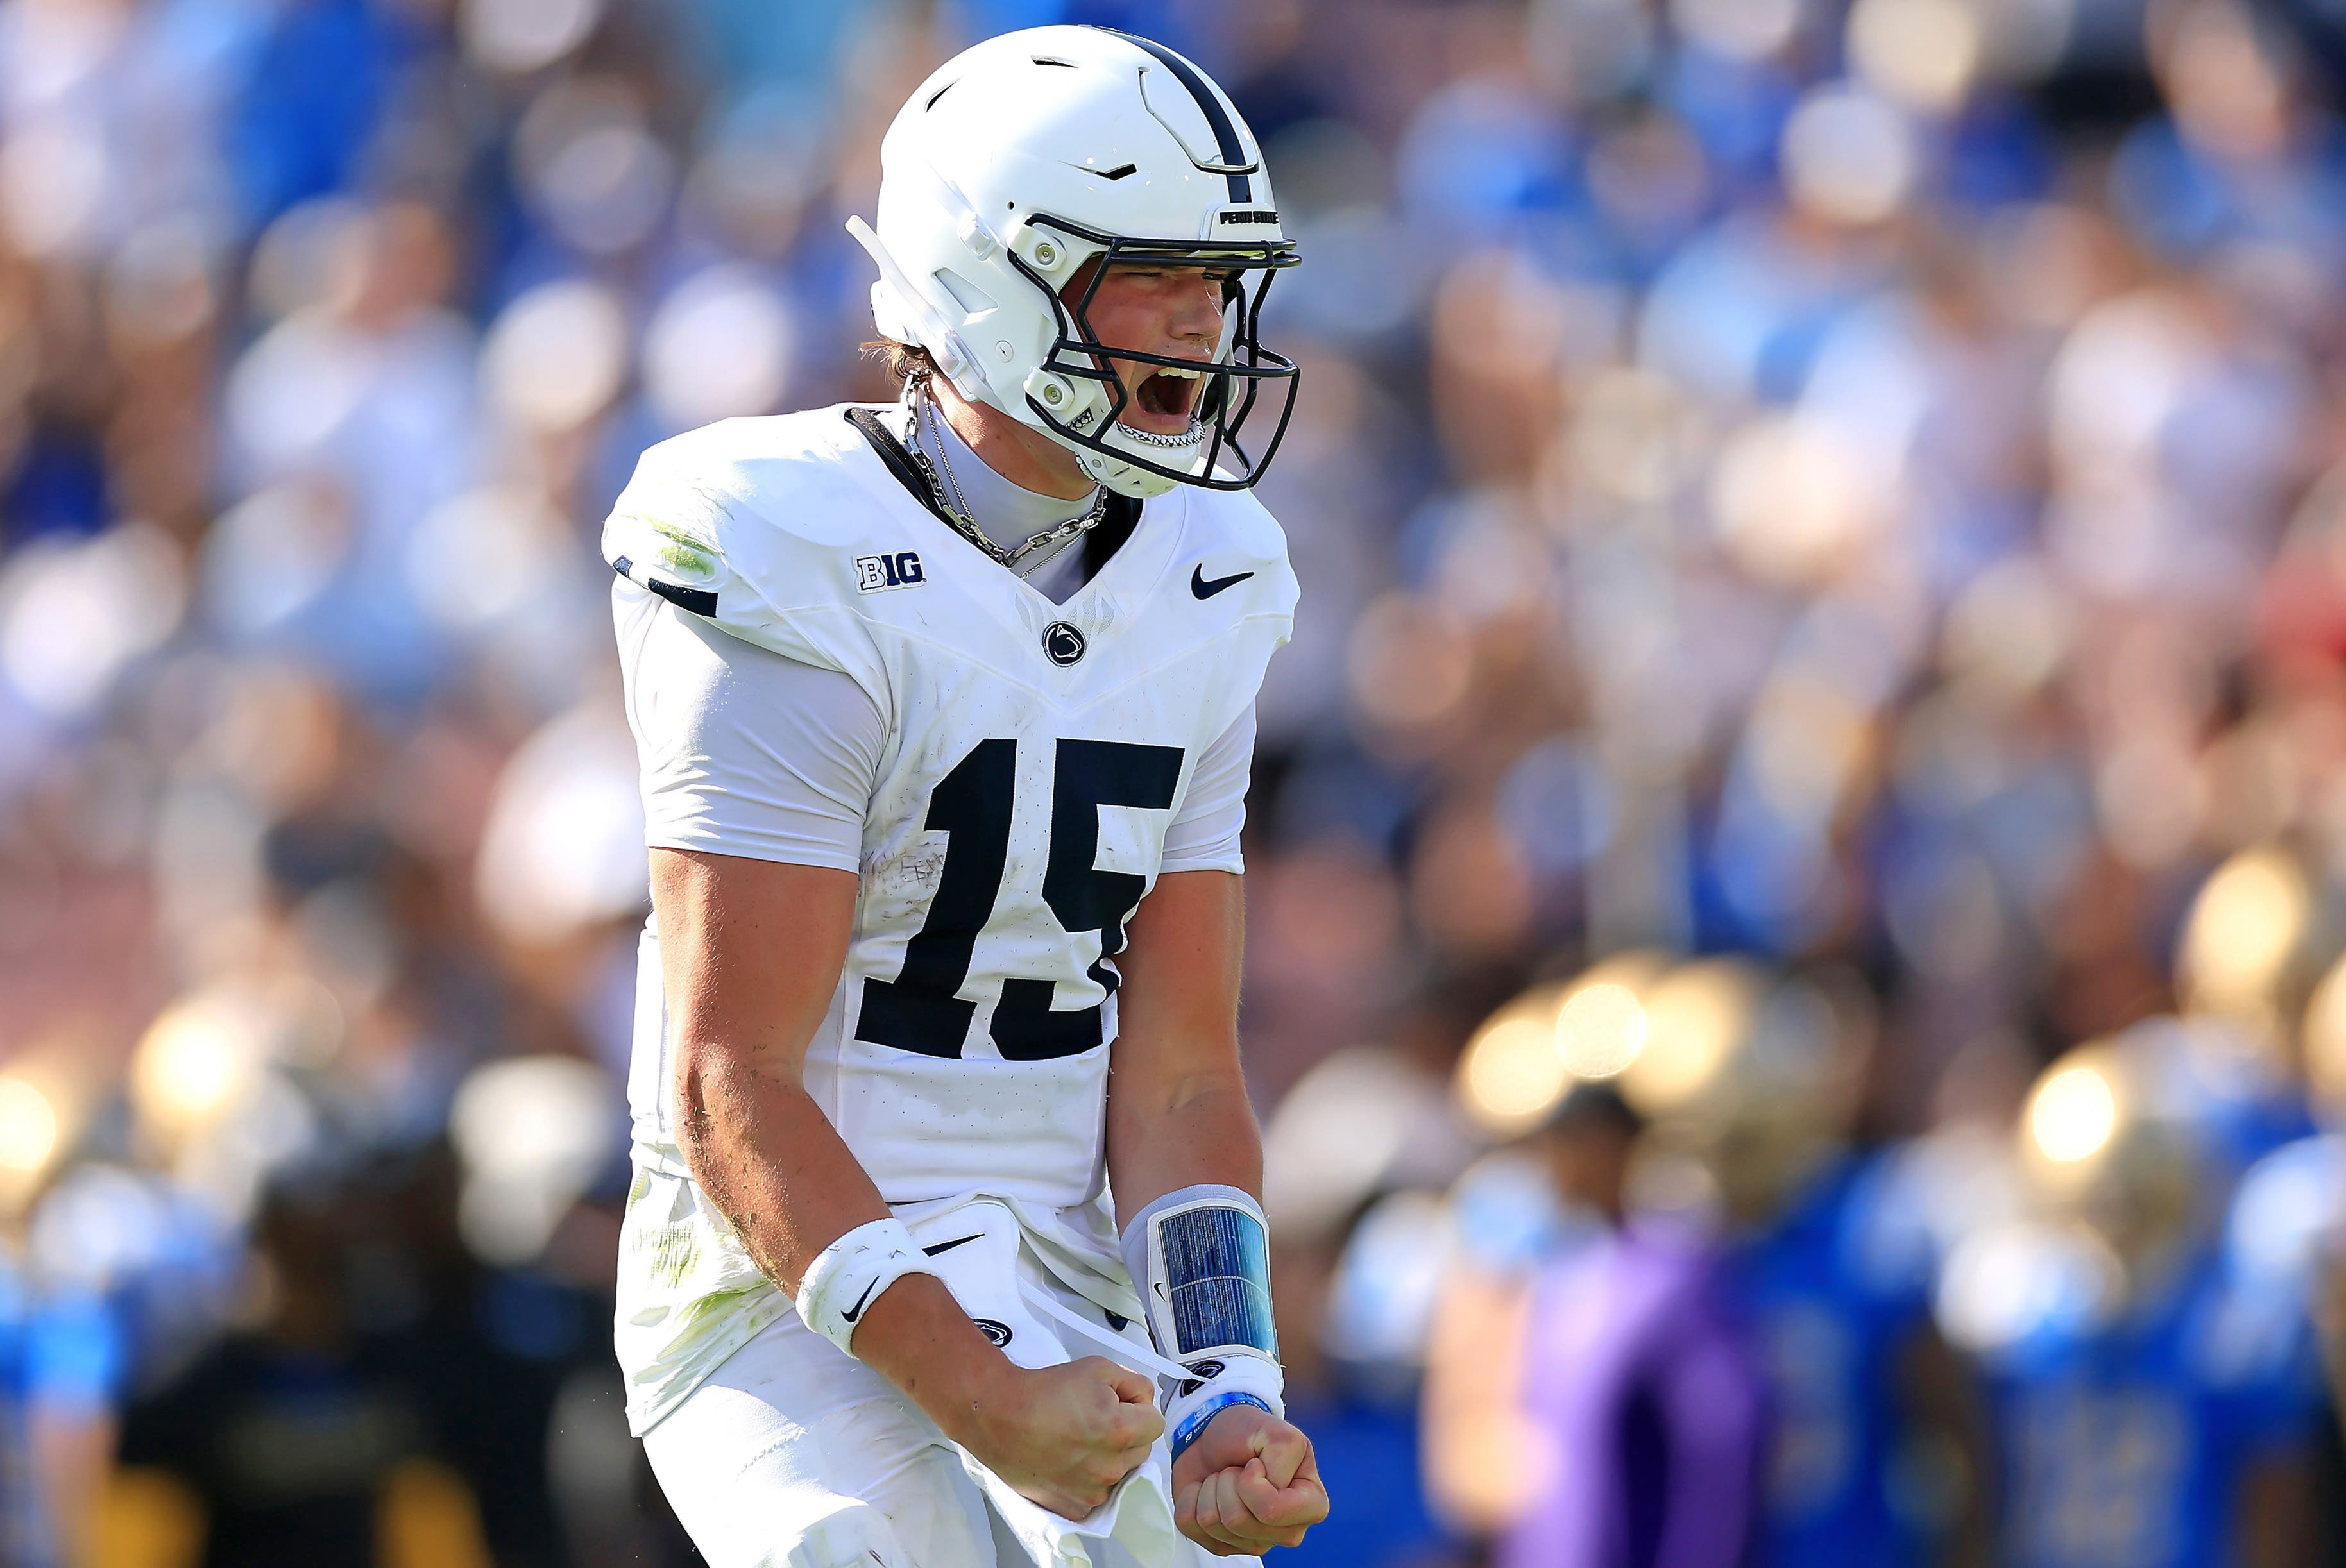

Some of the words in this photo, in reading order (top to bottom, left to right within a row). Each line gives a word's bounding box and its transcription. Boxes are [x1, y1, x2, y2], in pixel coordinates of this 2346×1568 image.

[1220, 211, 1254, 225] PENN
[1253, 211, 1279, 224] STATE
[853, 738, 1186, 1061] 15
